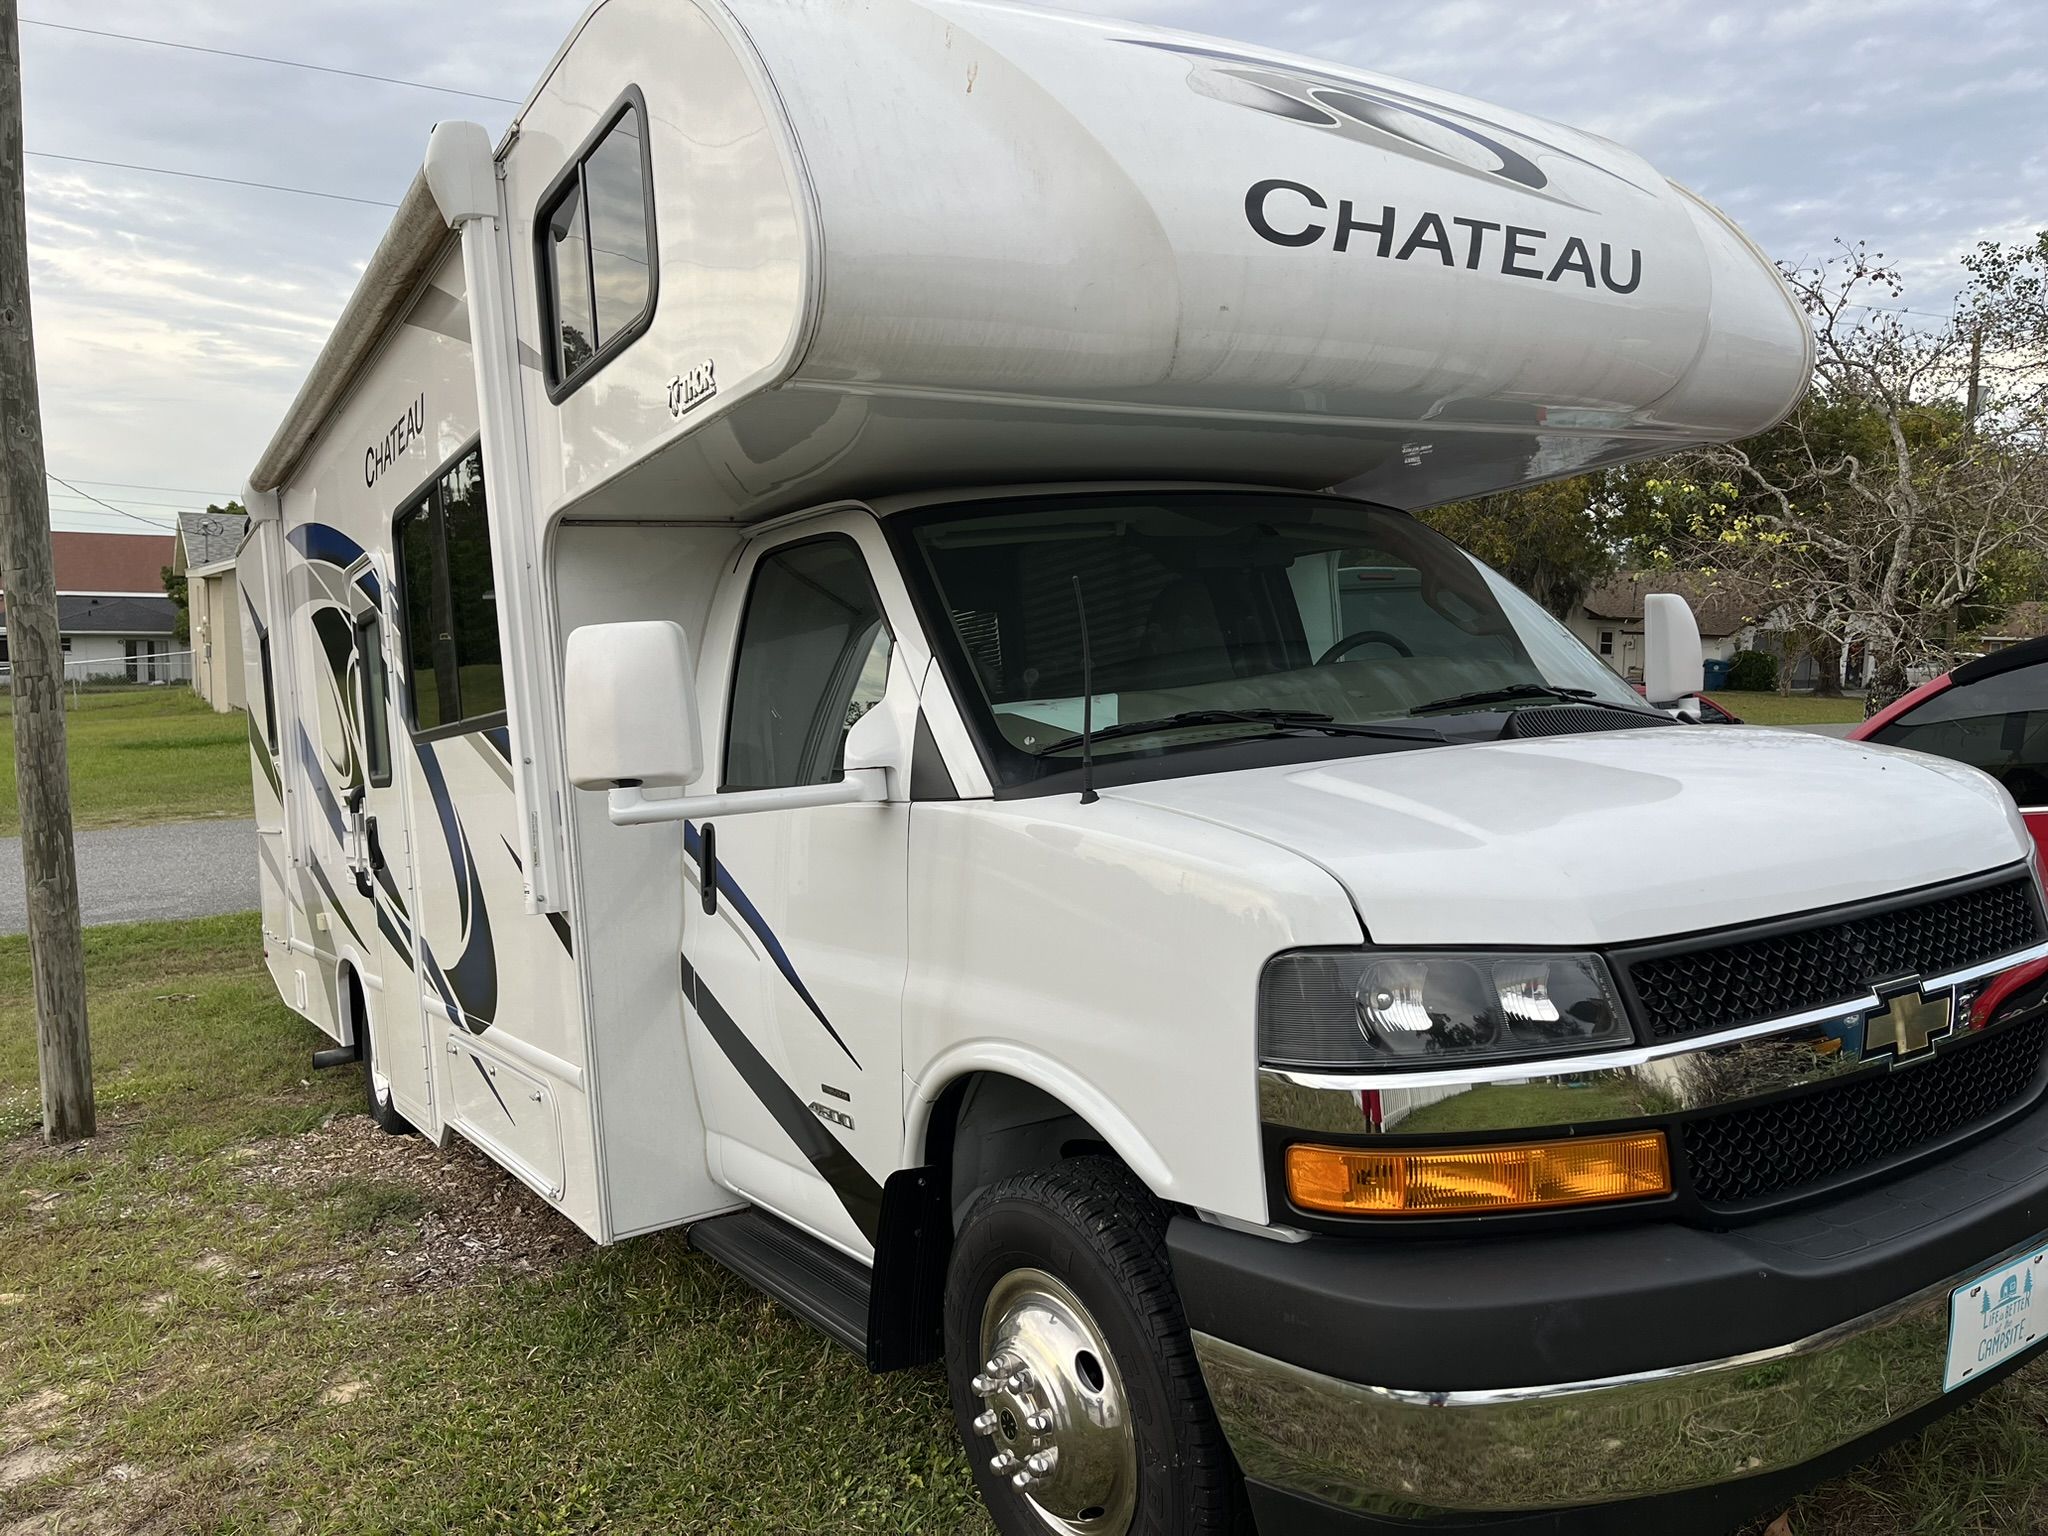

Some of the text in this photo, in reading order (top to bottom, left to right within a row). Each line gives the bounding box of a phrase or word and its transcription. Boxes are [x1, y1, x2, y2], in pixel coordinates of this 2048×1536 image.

[1244, 178, 1642, 295] CHATEAU
[681, 358, 716, 404] THOR
[365, 391, 425, 489] CHATEAU
[1978, 1318, 2026, 1362] CAMPSITE
